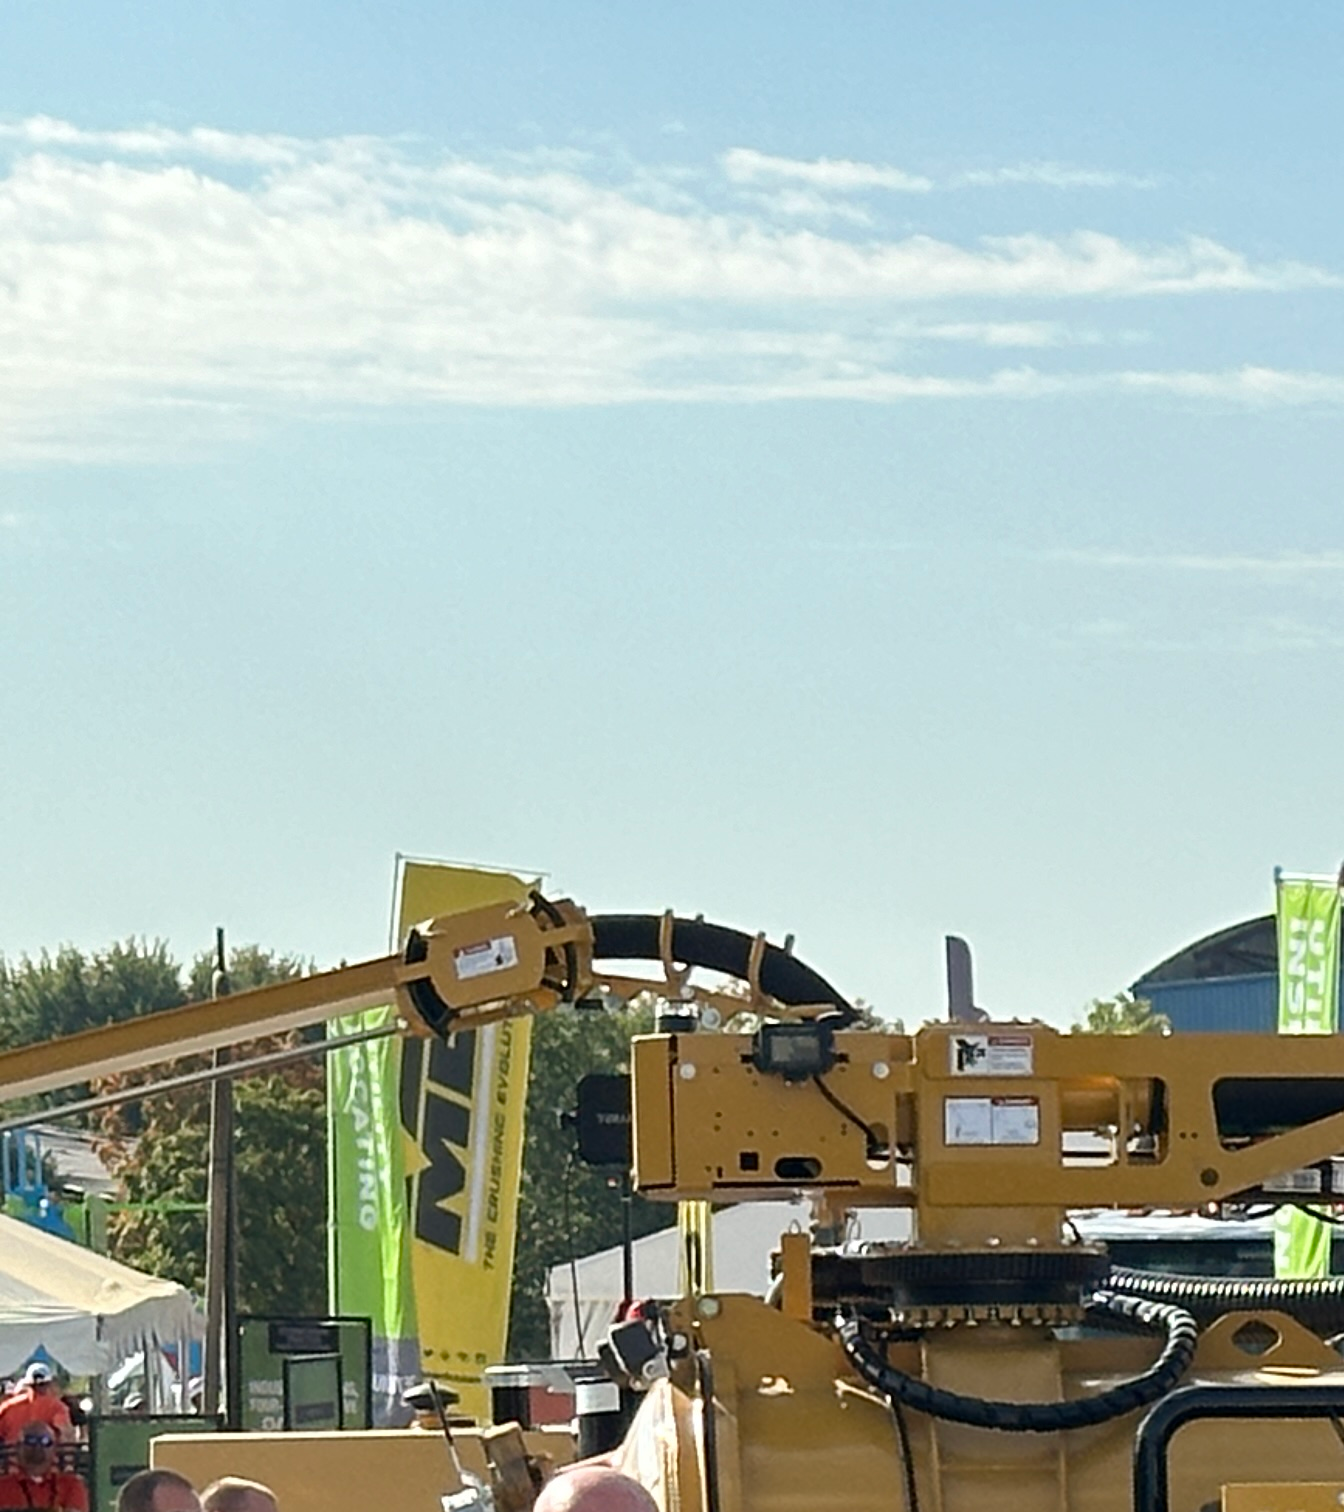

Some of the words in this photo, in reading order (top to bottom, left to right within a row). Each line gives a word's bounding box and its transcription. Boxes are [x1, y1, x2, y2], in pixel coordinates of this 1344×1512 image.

[496, 1019, 514, 1106] EVOLUT
[487, 1112, 507, 1222] CRUSHING
[482, 1232, 498, 1273] THE
